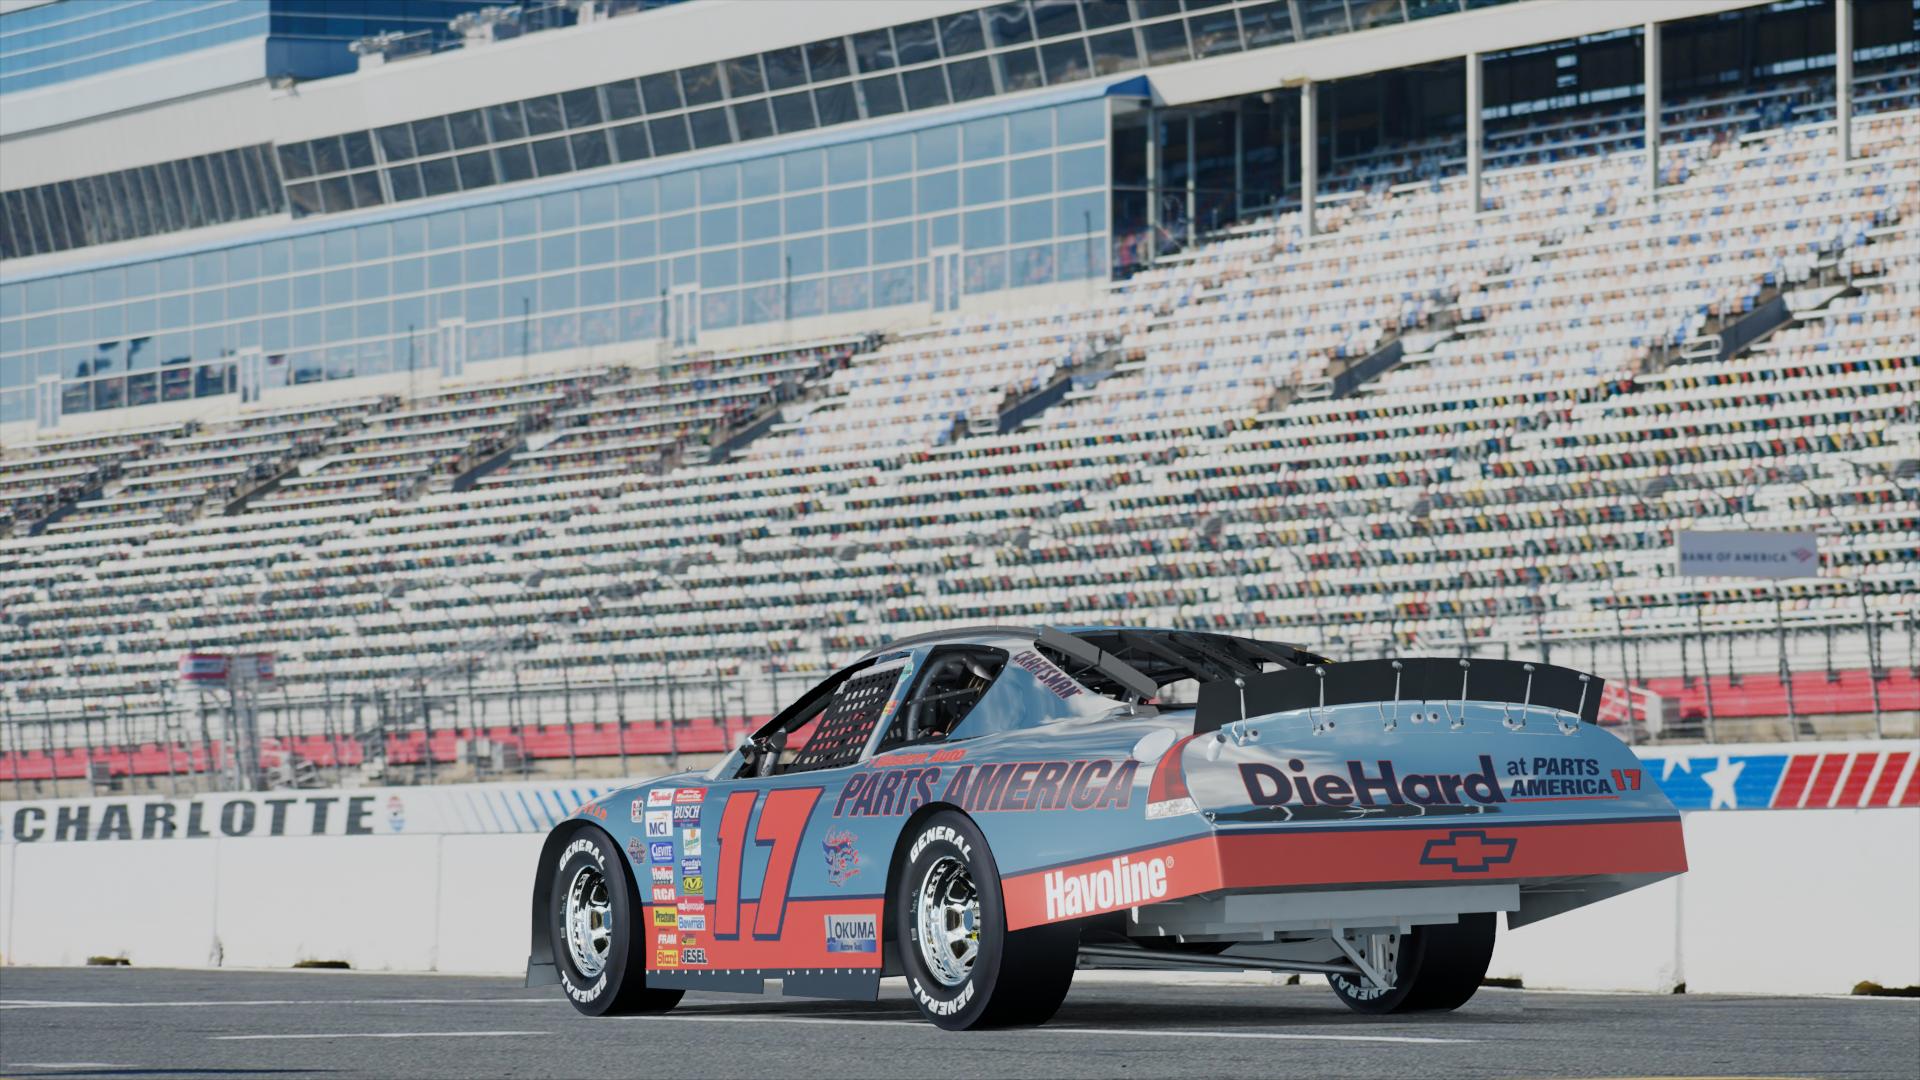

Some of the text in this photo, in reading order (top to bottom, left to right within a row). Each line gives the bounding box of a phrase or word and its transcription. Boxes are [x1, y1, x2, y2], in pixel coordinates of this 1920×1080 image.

[1681, 551, 1788, 563] BANK OF AMERICA
[1012, 650, 1083, 700] CRAFTSMAN
[1238, 754, 1508, 807] DieHard
[1507, 757, 1601, 776] at PARTS
[1611, 769, 1642, 791] 17
[832, 766, 941, 818] PARTS
[941, 759, 1140, 813] AMERICA
[1510, 778, 1613, 798] AMERICA
[13, 796, 376, 843] CHARLOTTE
[649, 822, 667, 835] MCI
[673, 805, 701, 819] BUSCH
[559, 839, 605, 872] GENERAL
[910, 826, 972, 864] GENERAL
[713, 785, 826, 941] 17
[678, 916, 705, 929] Bowman
[835, 921, 876, 939] OKUMA
[682, 948, 708, 964] JESEL
[562, 970, 608, 1003] GENERAL
[913, 977, 975, 1016] GENERAL
